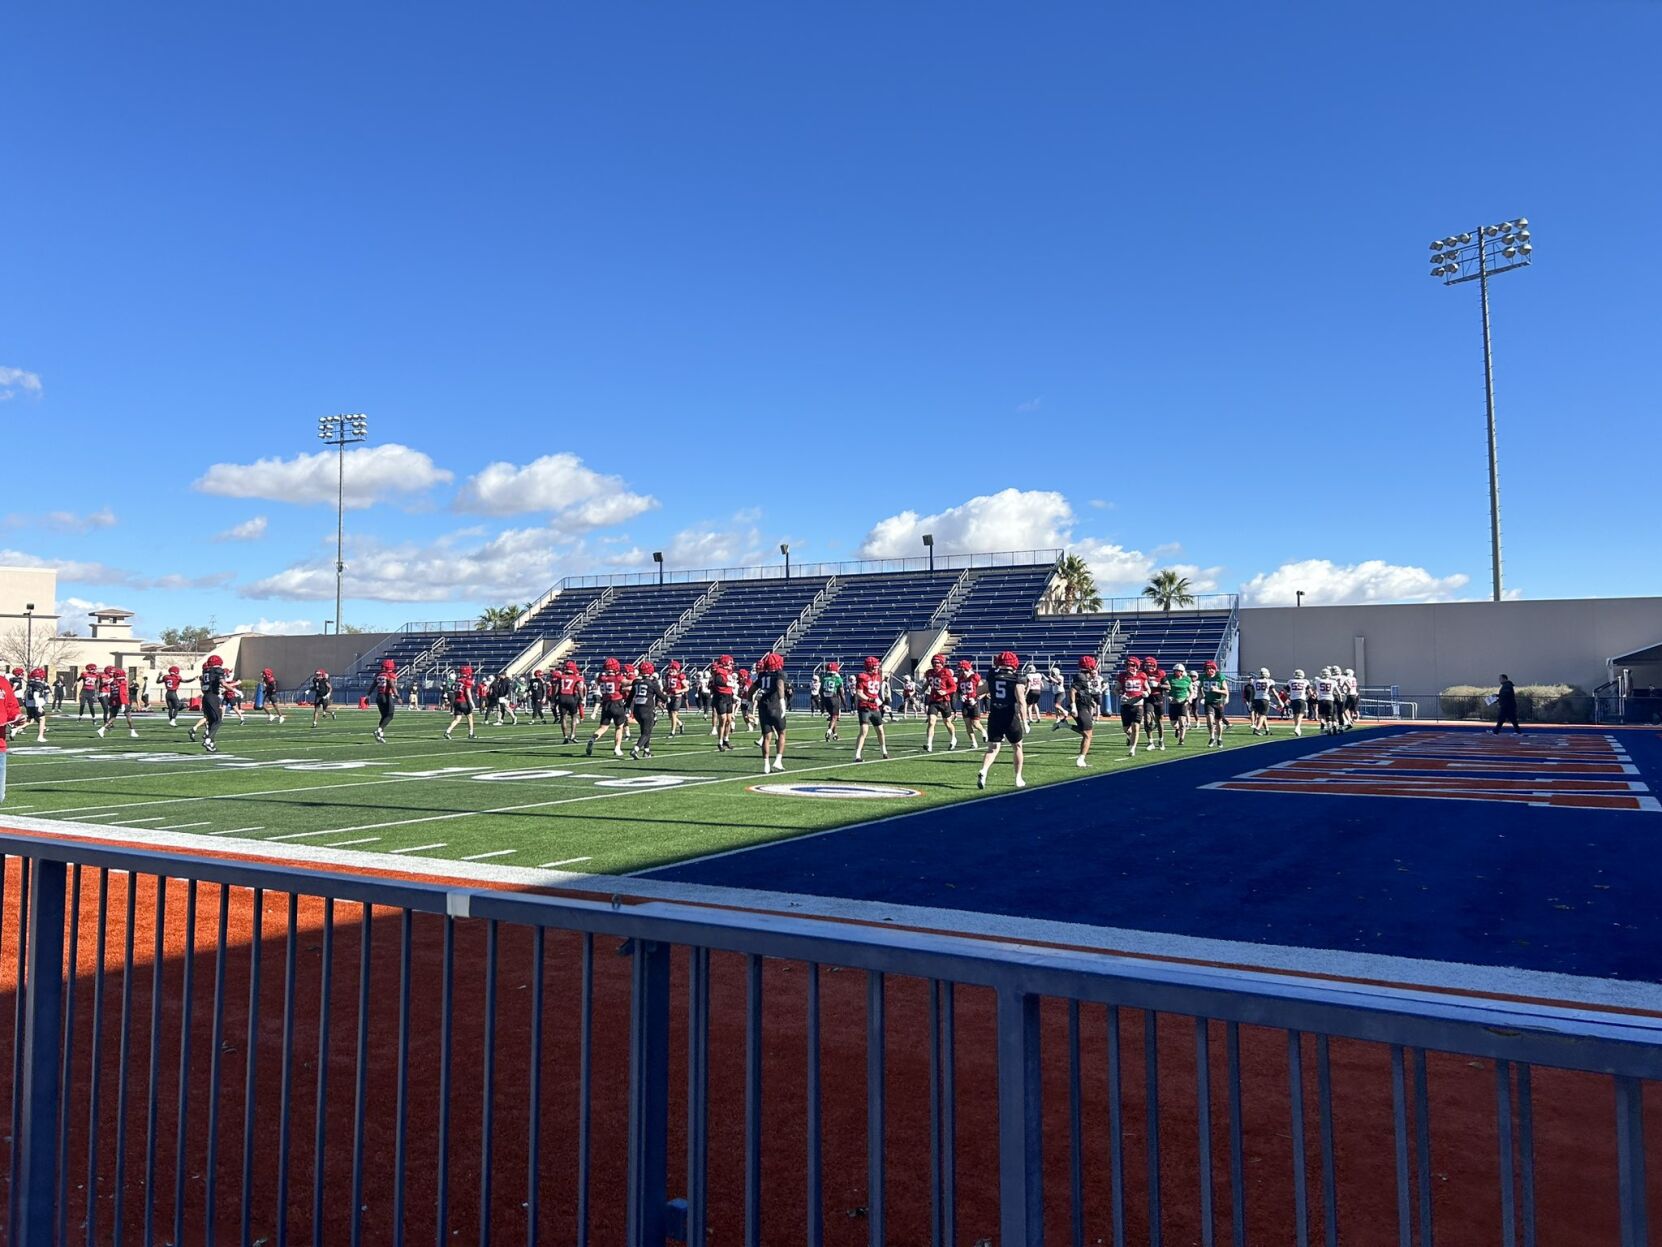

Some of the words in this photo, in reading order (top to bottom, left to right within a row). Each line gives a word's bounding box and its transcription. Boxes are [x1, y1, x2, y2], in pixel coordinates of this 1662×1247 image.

[560, 678, 574, 690] 17
[761, 676, 771, 689] 11
[994, 680, 1007, 699] 5
